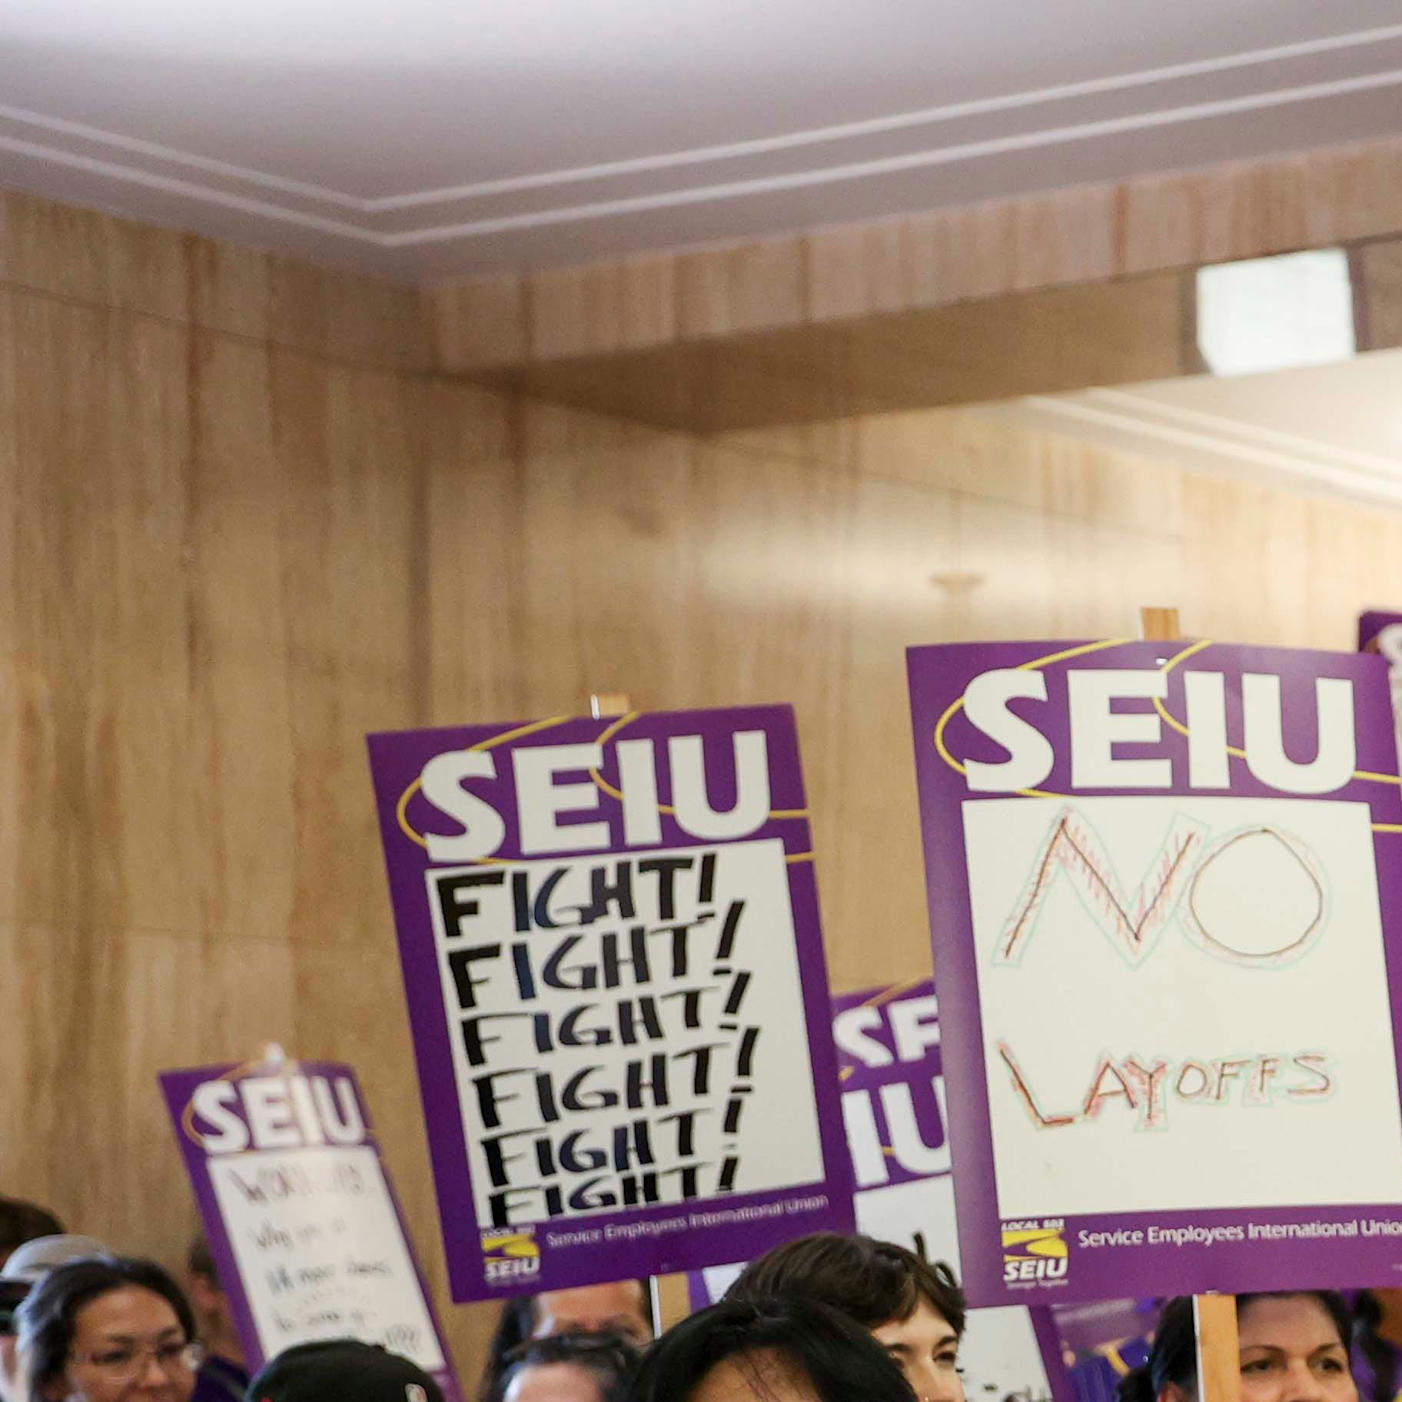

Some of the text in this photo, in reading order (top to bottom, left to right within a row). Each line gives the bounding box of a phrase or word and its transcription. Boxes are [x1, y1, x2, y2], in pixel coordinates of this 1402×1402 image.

[963, 668, 1356, 794] SEIU
[418, 730, 772, 862] SEIU
[436, 853, 718, 937] FIGHT!
[992, 808, 1332, 970] NO
[448, 900, 746, 1008] FIGHT!
[460, 972, 752, 1066] FIGHT!
[192, 1075, 367, 1155] SEIU
[473, 1026, 760, 1129] FIGHT!
[998, 1039, 1337, 1133] LAYOFFS
[481, 1091, 744, 1188] FIGHT!
[1003, 1257, 1068, 1282] SEIU
[1078, 1227, 1144, 1248] Service
[1147, 1224, 1245, 1247] Employees
[1248, 1219, 1358, 1240] International
